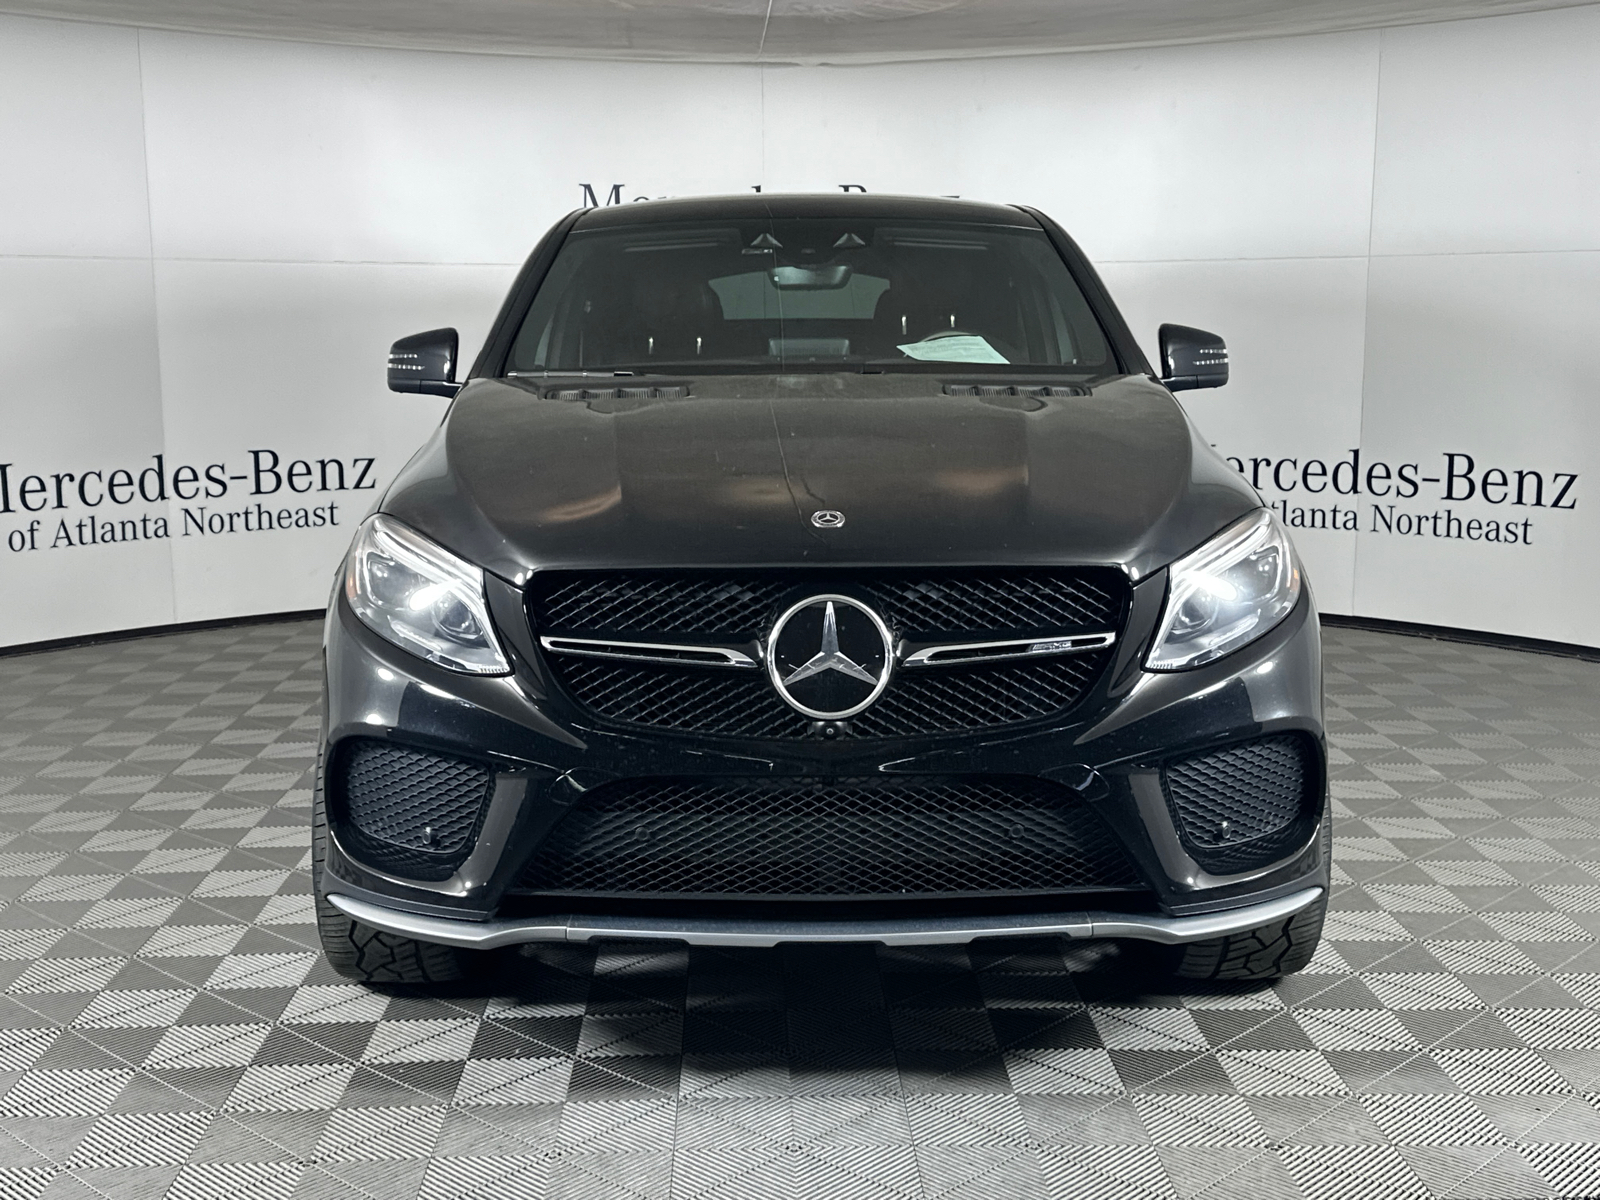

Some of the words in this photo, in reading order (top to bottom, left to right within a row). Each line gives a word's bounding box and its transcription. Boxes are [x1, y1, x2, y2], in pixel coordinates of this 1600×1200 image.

[1211, 445, 1579, 510] rcedes-Benz
[8, 520, 41, 552] of
[50, 515, 170, 549] Atlanta
[181, 502, 339, 537] Northeast
[1370, 504, 1534, 546] Northeast
